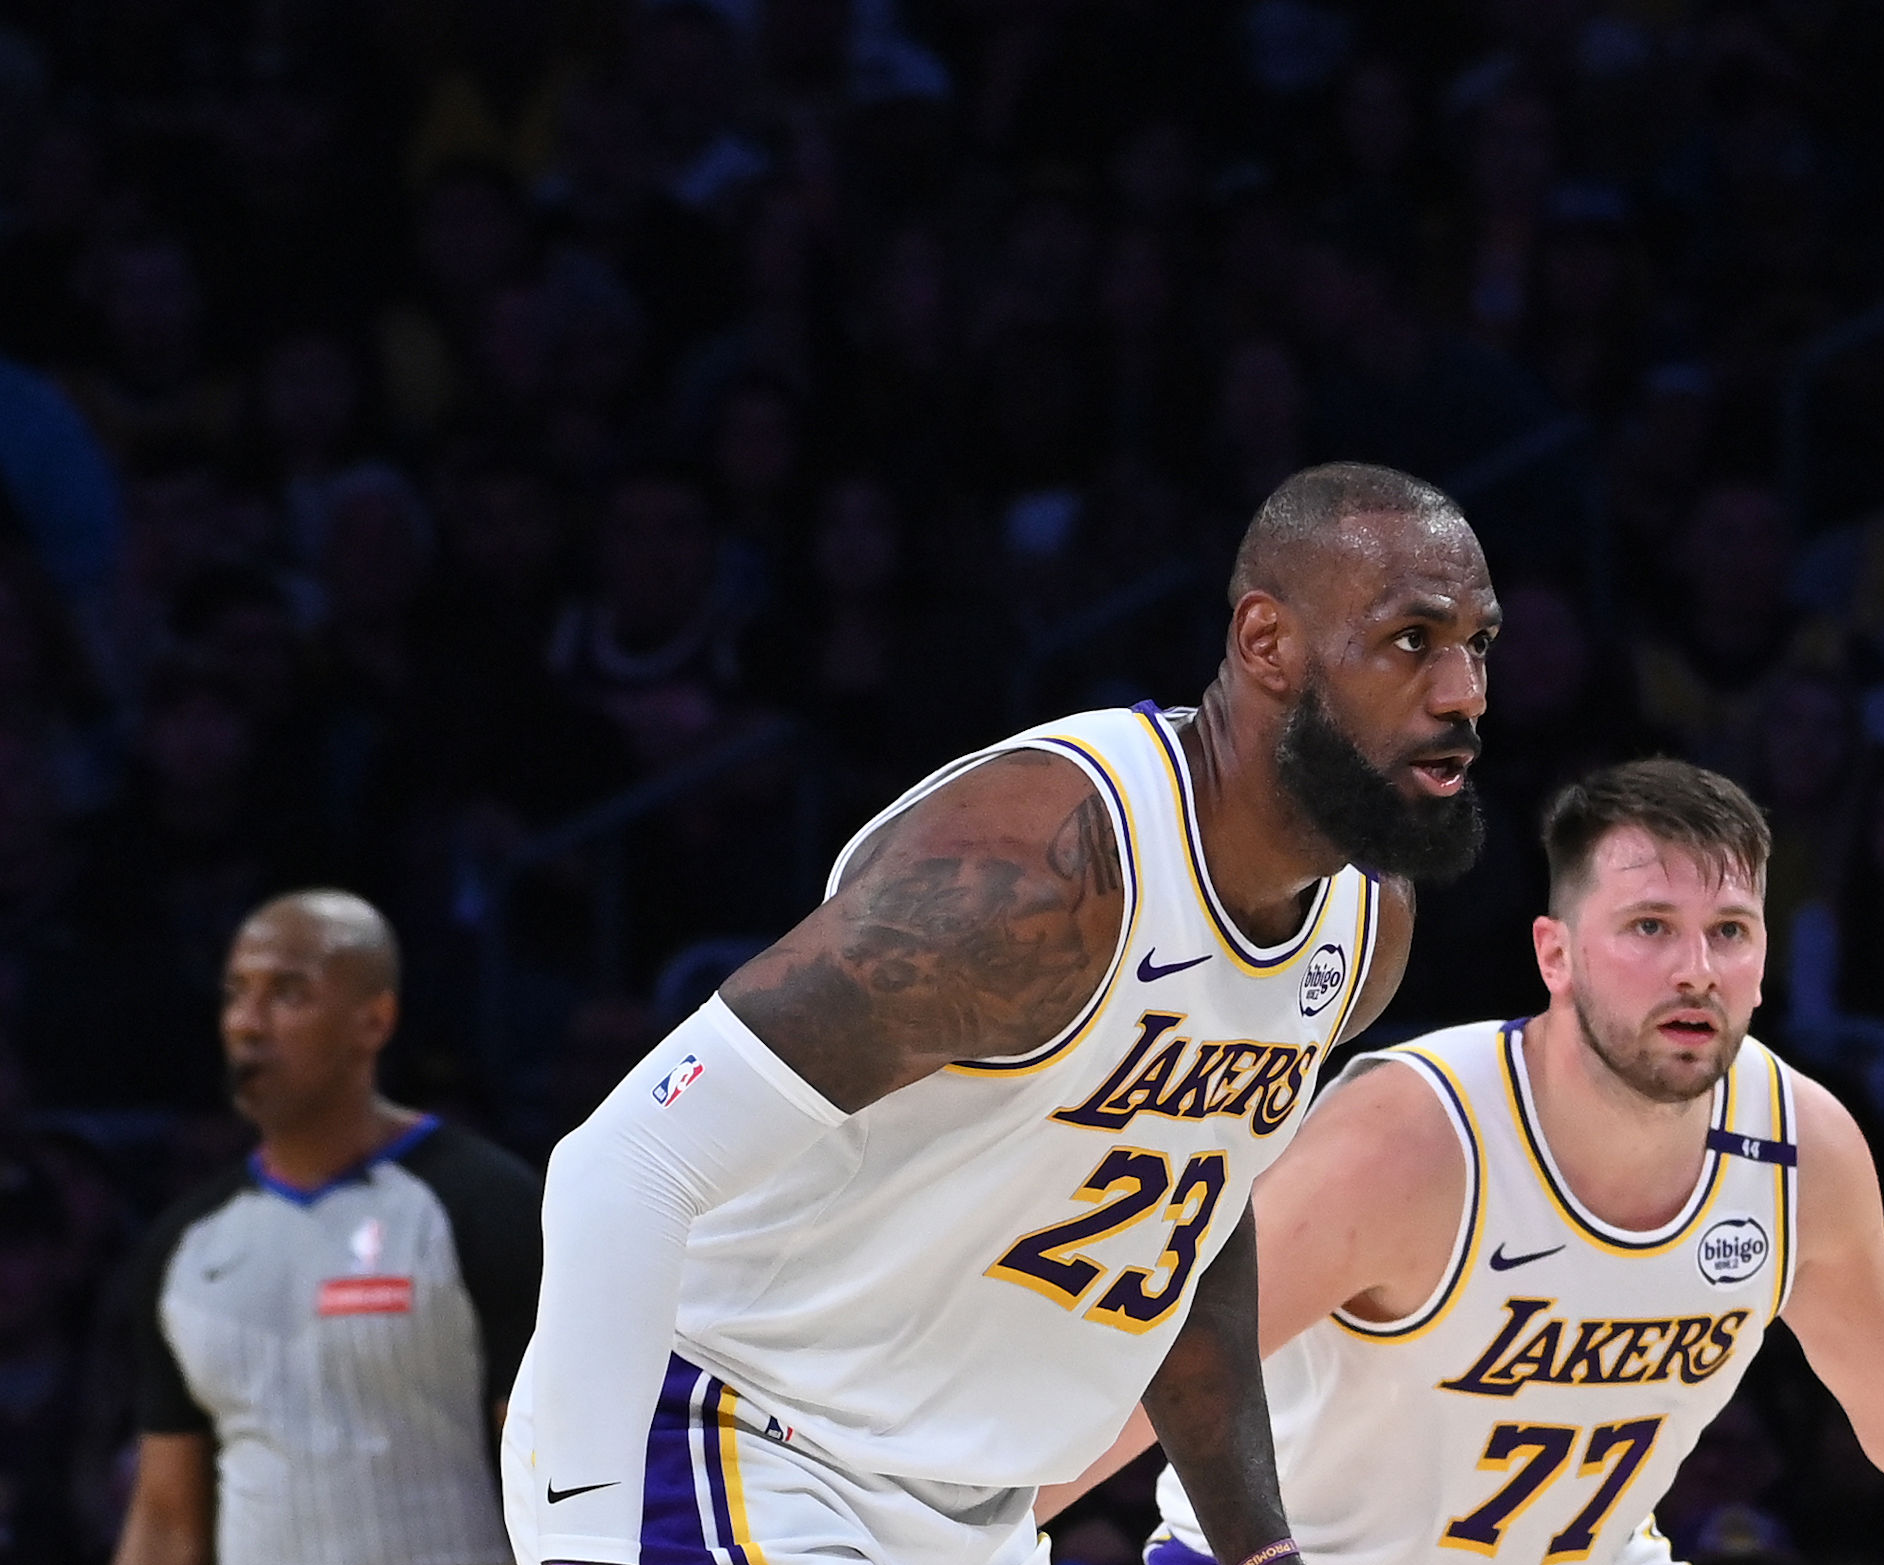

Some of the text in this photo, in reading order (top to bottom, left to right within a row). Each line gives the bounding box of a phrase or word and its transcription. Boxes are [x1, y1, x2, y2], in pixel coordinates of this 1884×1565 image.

[1304, 963, 1341, 995] bibigo
[1046, 1009, 1319, 1138] LAKERS
[983, 1145, 1230, 1335] 23
[1704, 1236, 1764, 1263] bibigo
[1434, 1296, 1754, 1400] LAKERS
